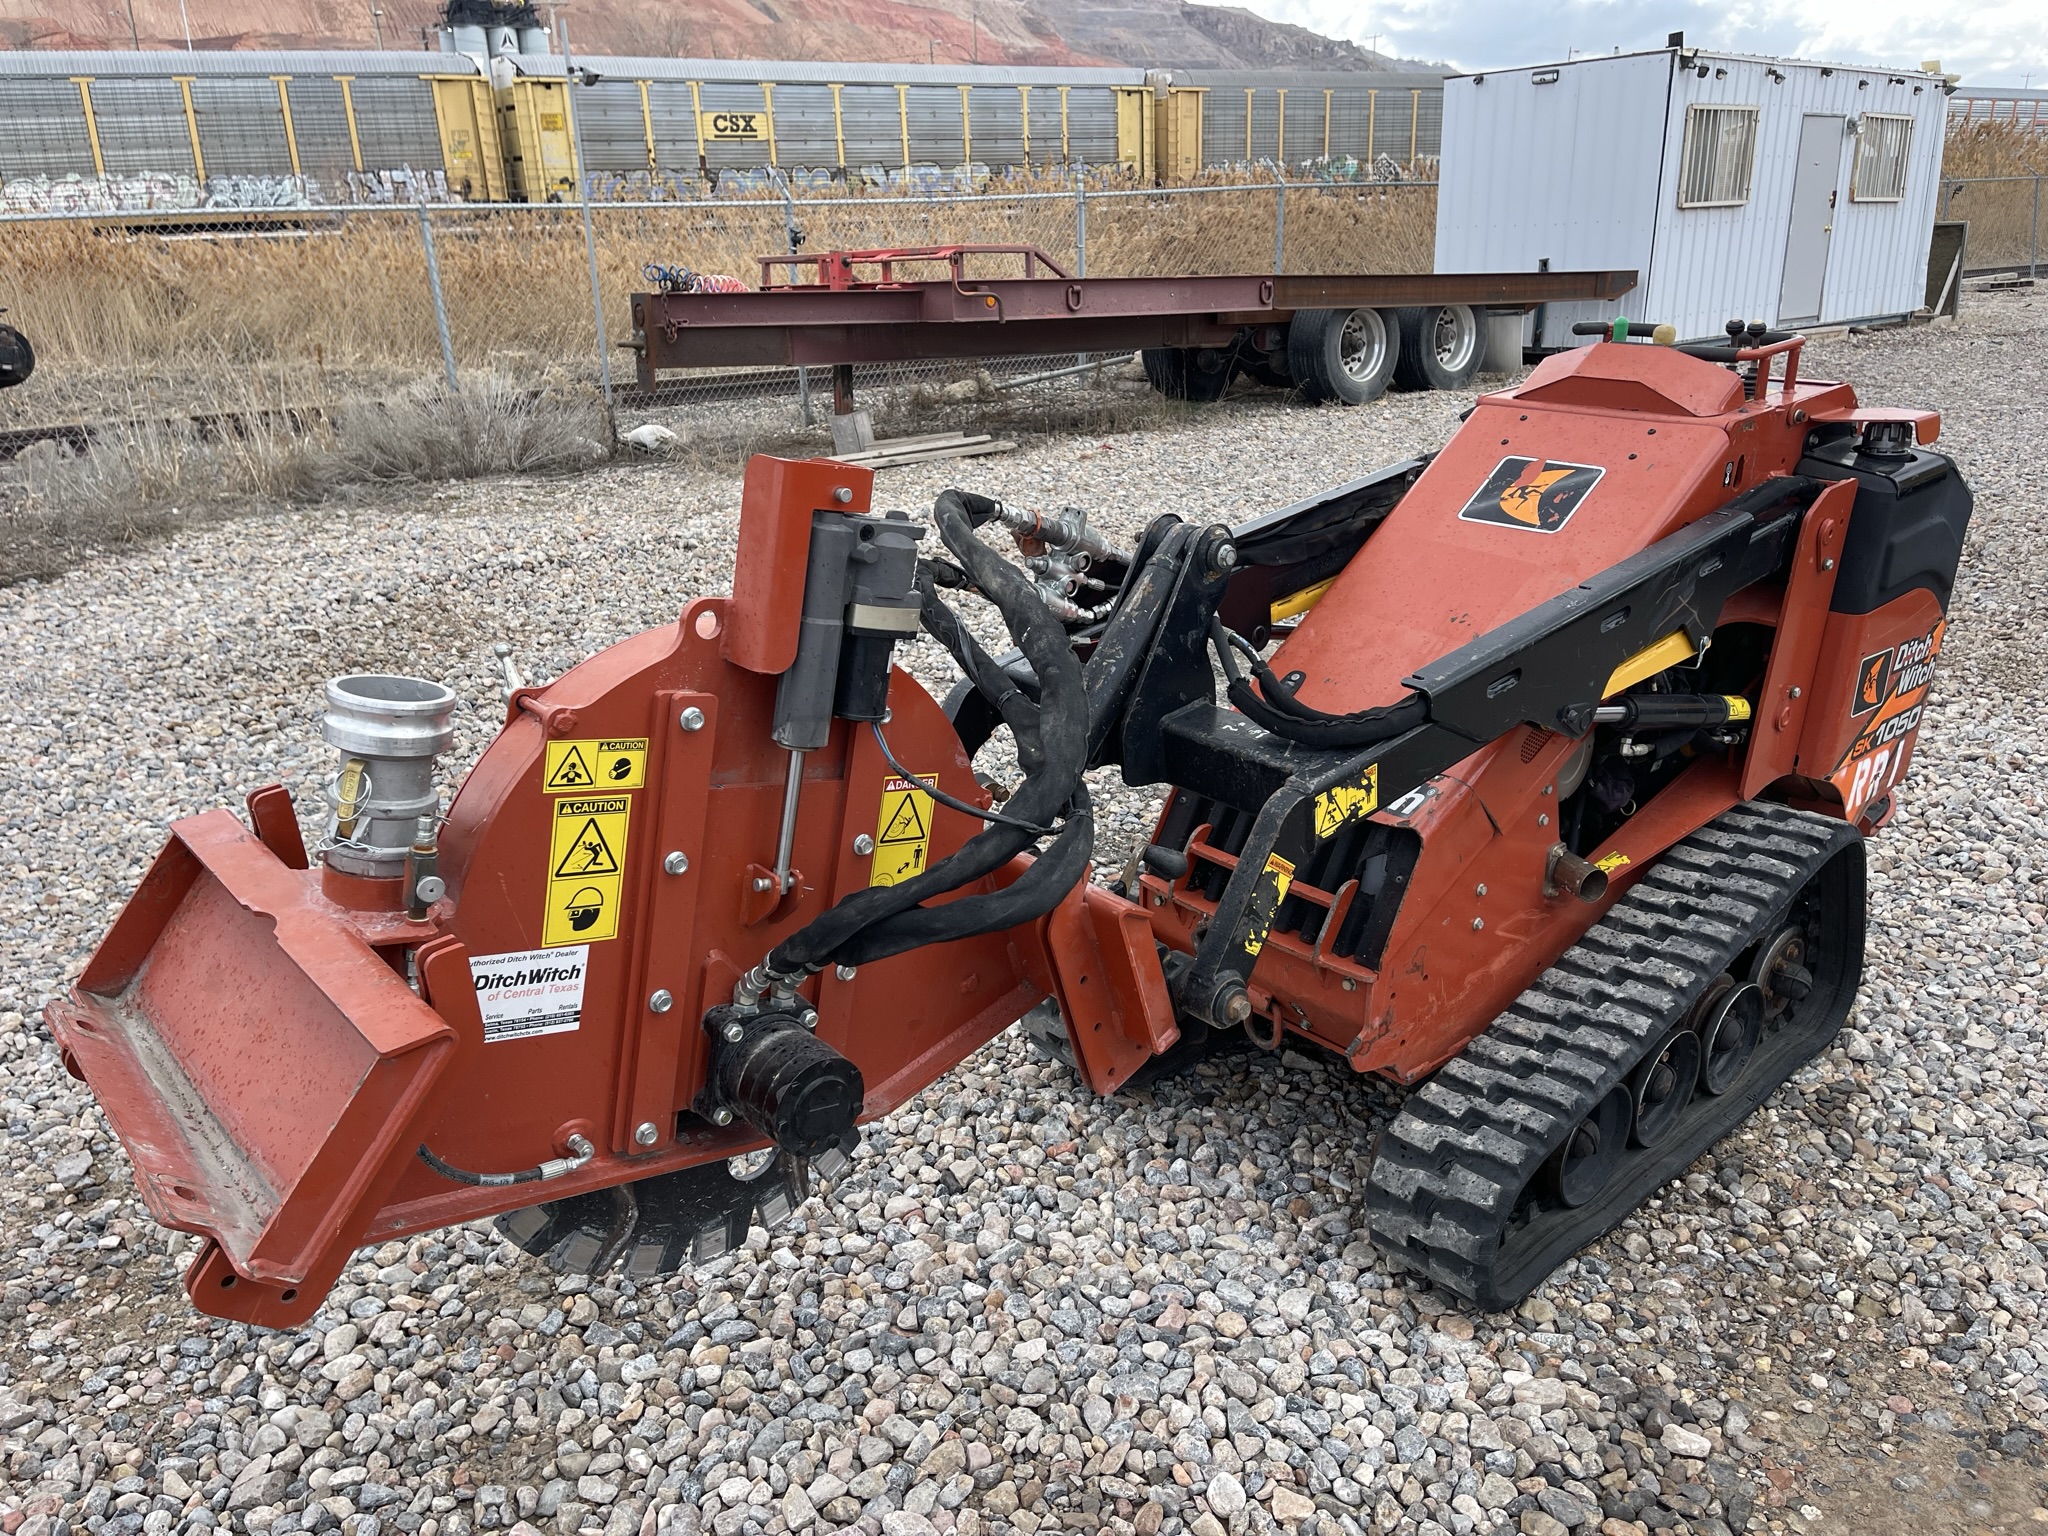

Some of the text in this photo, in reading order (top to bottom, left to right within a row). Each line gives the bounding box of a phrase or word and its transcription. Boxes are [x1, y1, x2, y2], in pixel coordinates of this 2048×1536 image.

[713, 114, 758, 133] CSX
[1893, 633, 1933, 671] Ditch
[1897, 658, 1937, 695] Witch
[1853, 705, 1923, 757] SK 1050
[609, 742, 644, 750] CAUTION
[895, 778, 934, 790] DANER
[573, 800, 625, 813] CAUTION
[470, 957, 506, 968] uthorized
[507, 955, 528, 963] Ditch
[555, 950, 579, 958] Dealer
[487, 983, 580, 1002] of Central Texas
[485, 1003, 578, 1021] Service Parts Rentals
